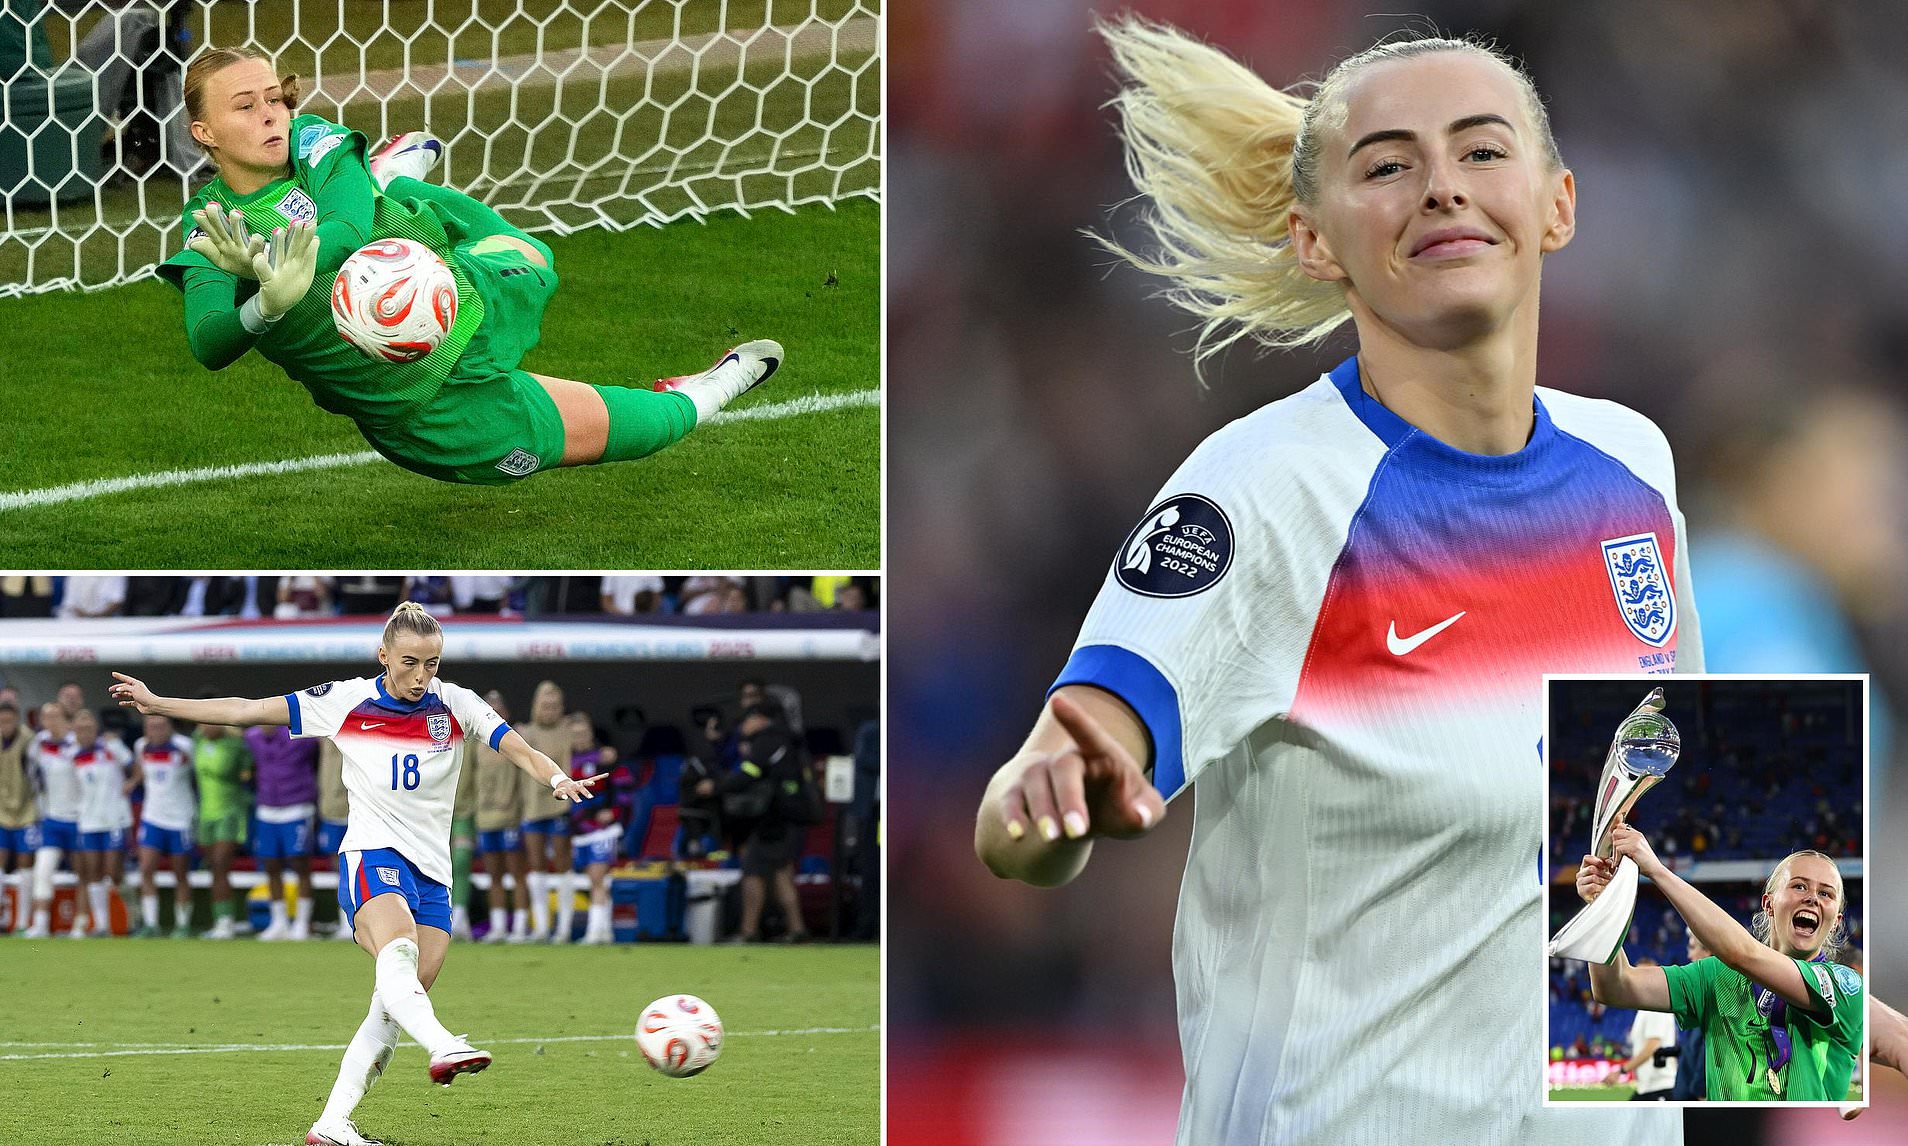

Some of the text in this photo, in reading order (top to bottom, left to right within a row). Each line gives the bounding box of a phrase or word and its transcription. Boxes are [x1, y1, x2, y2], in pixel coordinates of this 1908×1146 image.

[1163, 534, 1219, 562] EUROPEAN
[1182, 527, 1212, 545] UEFA
[1155, 543, 1217, 573] CHAMPIONS
[1160, 557, 1198, 578] 2022
[1638, 652, 1665, 668] ENGLAND
[392, 753, 420, 790] 18
